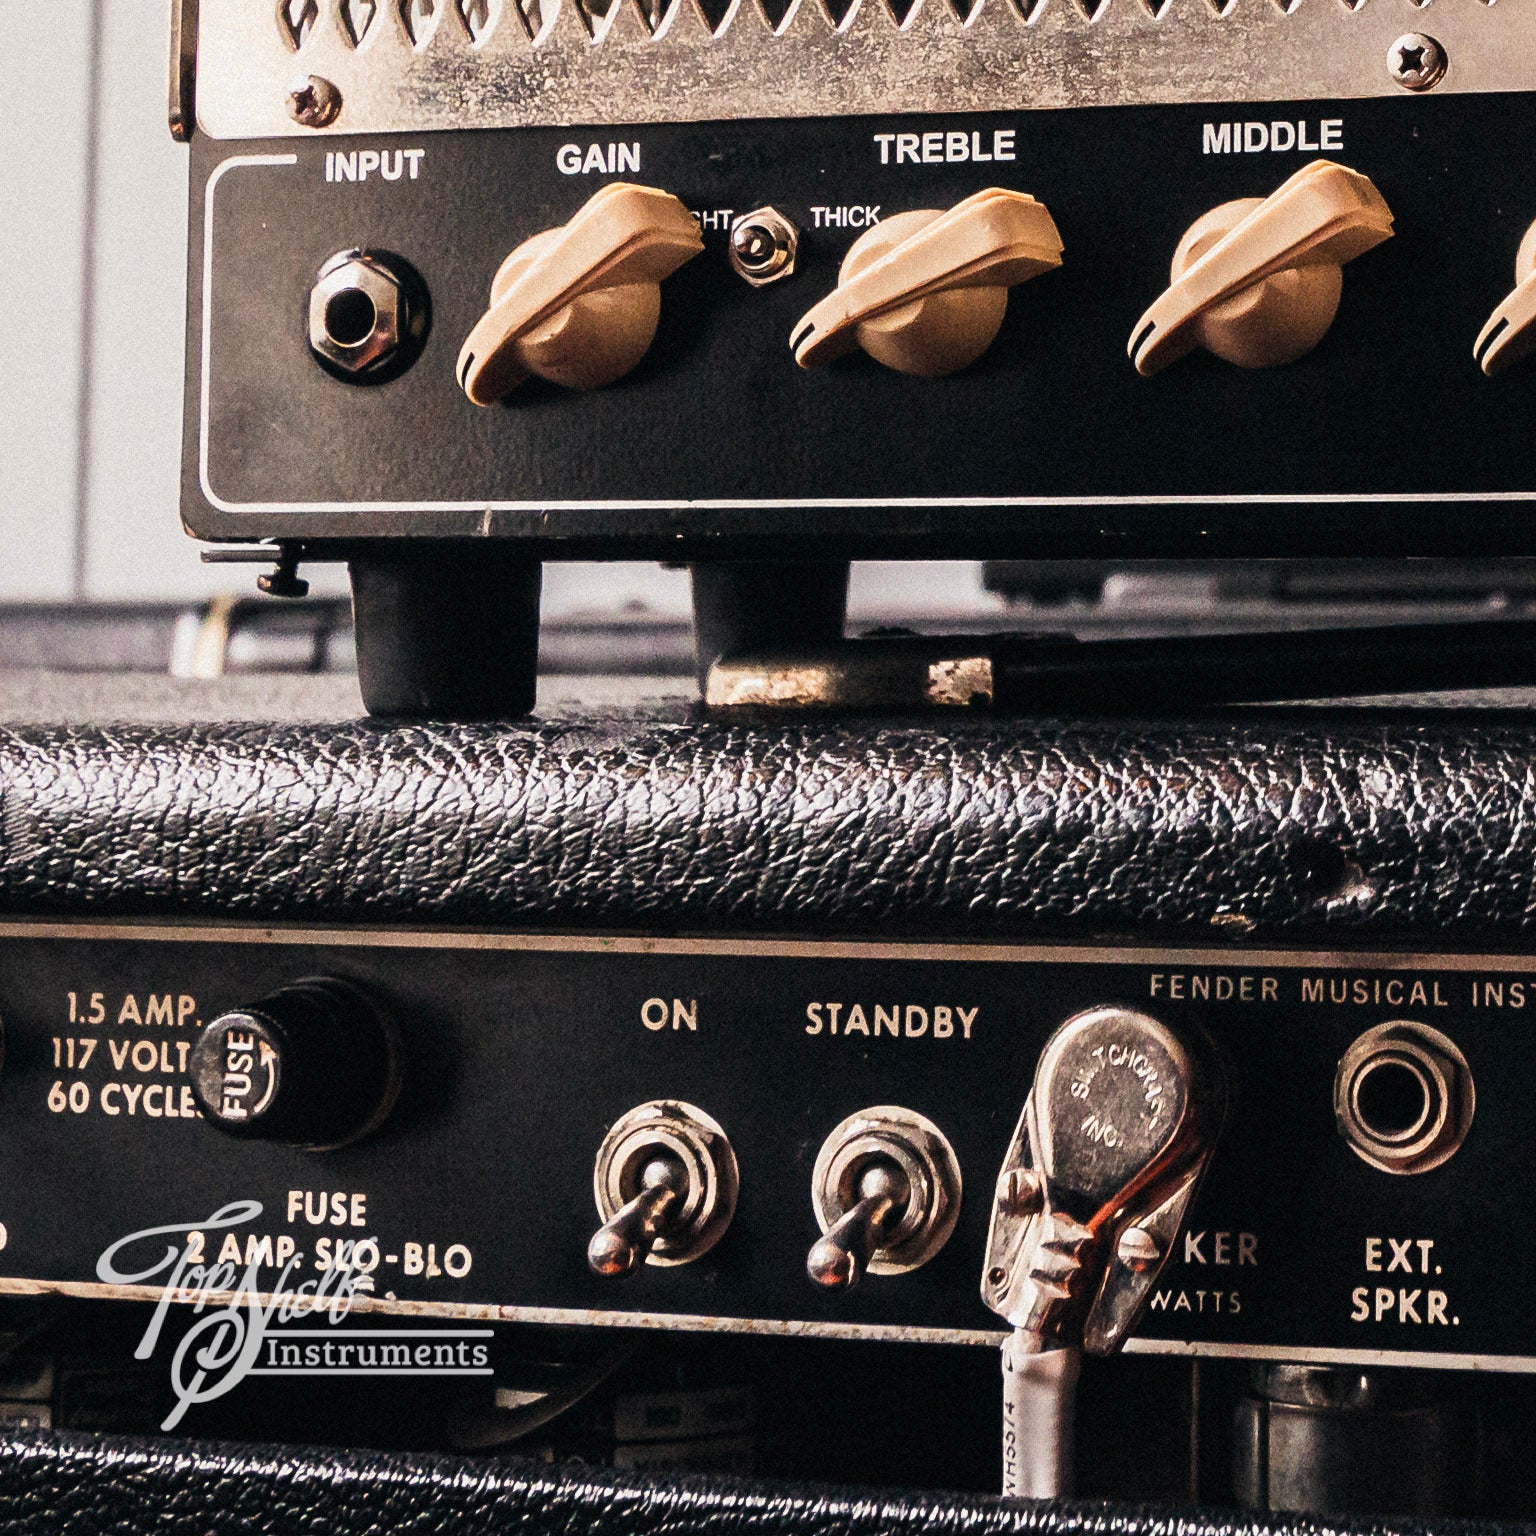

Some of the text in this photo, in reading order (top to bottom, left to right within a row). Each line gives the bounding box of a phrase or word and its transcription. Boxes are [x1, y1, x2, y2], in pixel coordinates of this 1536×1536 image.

[874, 130, 1015, 164] TREBLE
[1203, 119, 1343, 154] MIDDLE
[326, 149, 425, 182] INPUT
[557, 143, 640, 174] GAIN
[810, 205, 881, 228] THICK
[1150, 974, 1278, 1000] FENDER
[1302, 978, 1447, 1006] MUSICAL
[68, 992, 201, 1026] 1.5 AMP.
[641, 998, 696, 1030] ON
[805, 1002, 978, 1038] STANDBY
[53, 1038, 97, 1069] 117
[221, 1030, 255, 1119] FUSE
[48, 1081, 204, 1118] 60 CYCLE
[288, 1191, 366, 1226] FUSE
[187, 1231, 205, 1264] 2
[218, 1233, 301, 1269] AMP.
[1366, 1238, 1441, 1274] EXT.
[1151, 1290, 1240, 1312] WATTS
[1351, 1287, 1459, 1325] SPKR.
